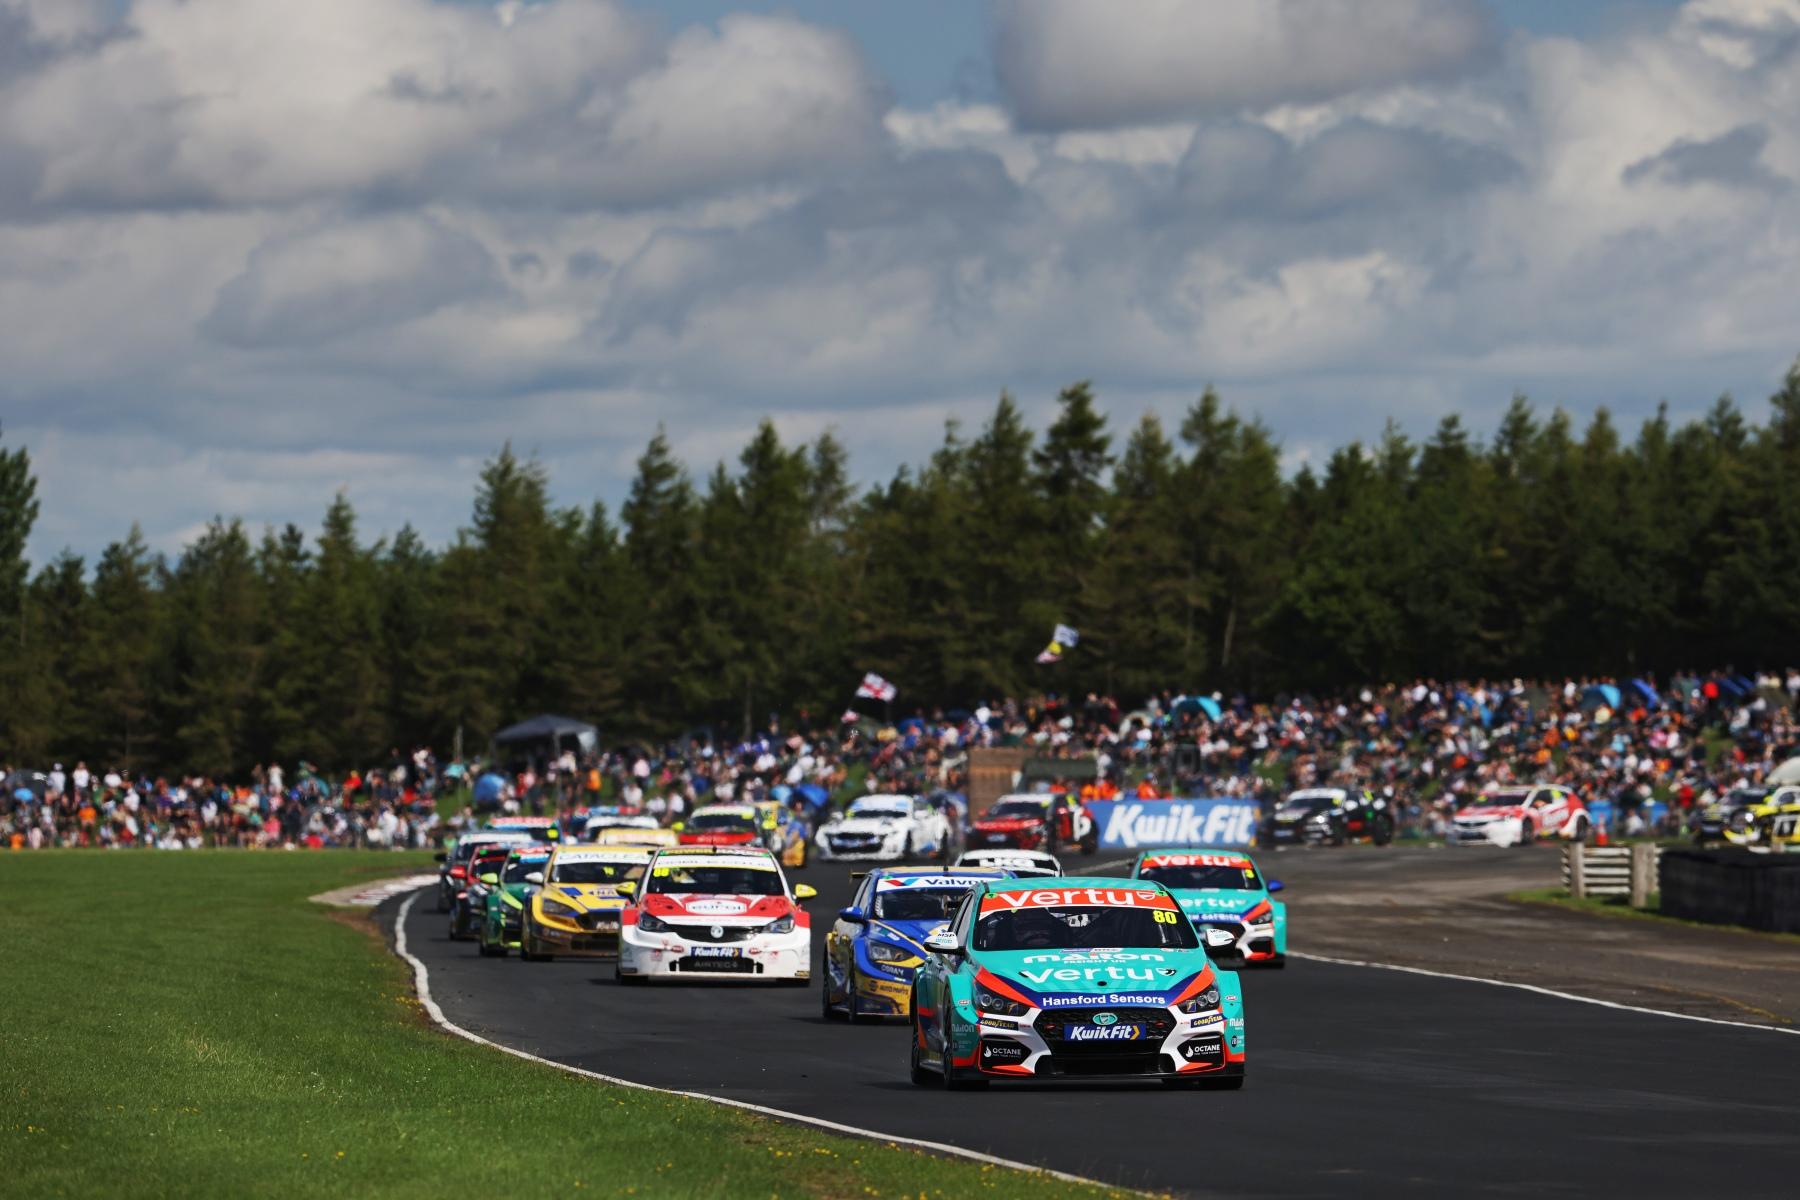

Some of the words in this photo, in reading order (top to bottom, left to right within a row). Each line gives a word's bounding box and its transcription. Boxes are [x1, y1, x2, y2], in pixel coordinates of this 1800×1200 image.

[999, 887, 1136, 908] vertu
[1153, 909, 1177, 925] 80
[1026, 966, 1155, 984] vertu
[1042, 994, 1106, 1007] Hansford
[1109, 993, 1165, 1005] Sensors
[1193, 1014, 1223, 1026] GOODYEAR
[992, 1047, 1021, 1056] OCTANE
[1194, 1044, 1220, 1053] OCTANE
